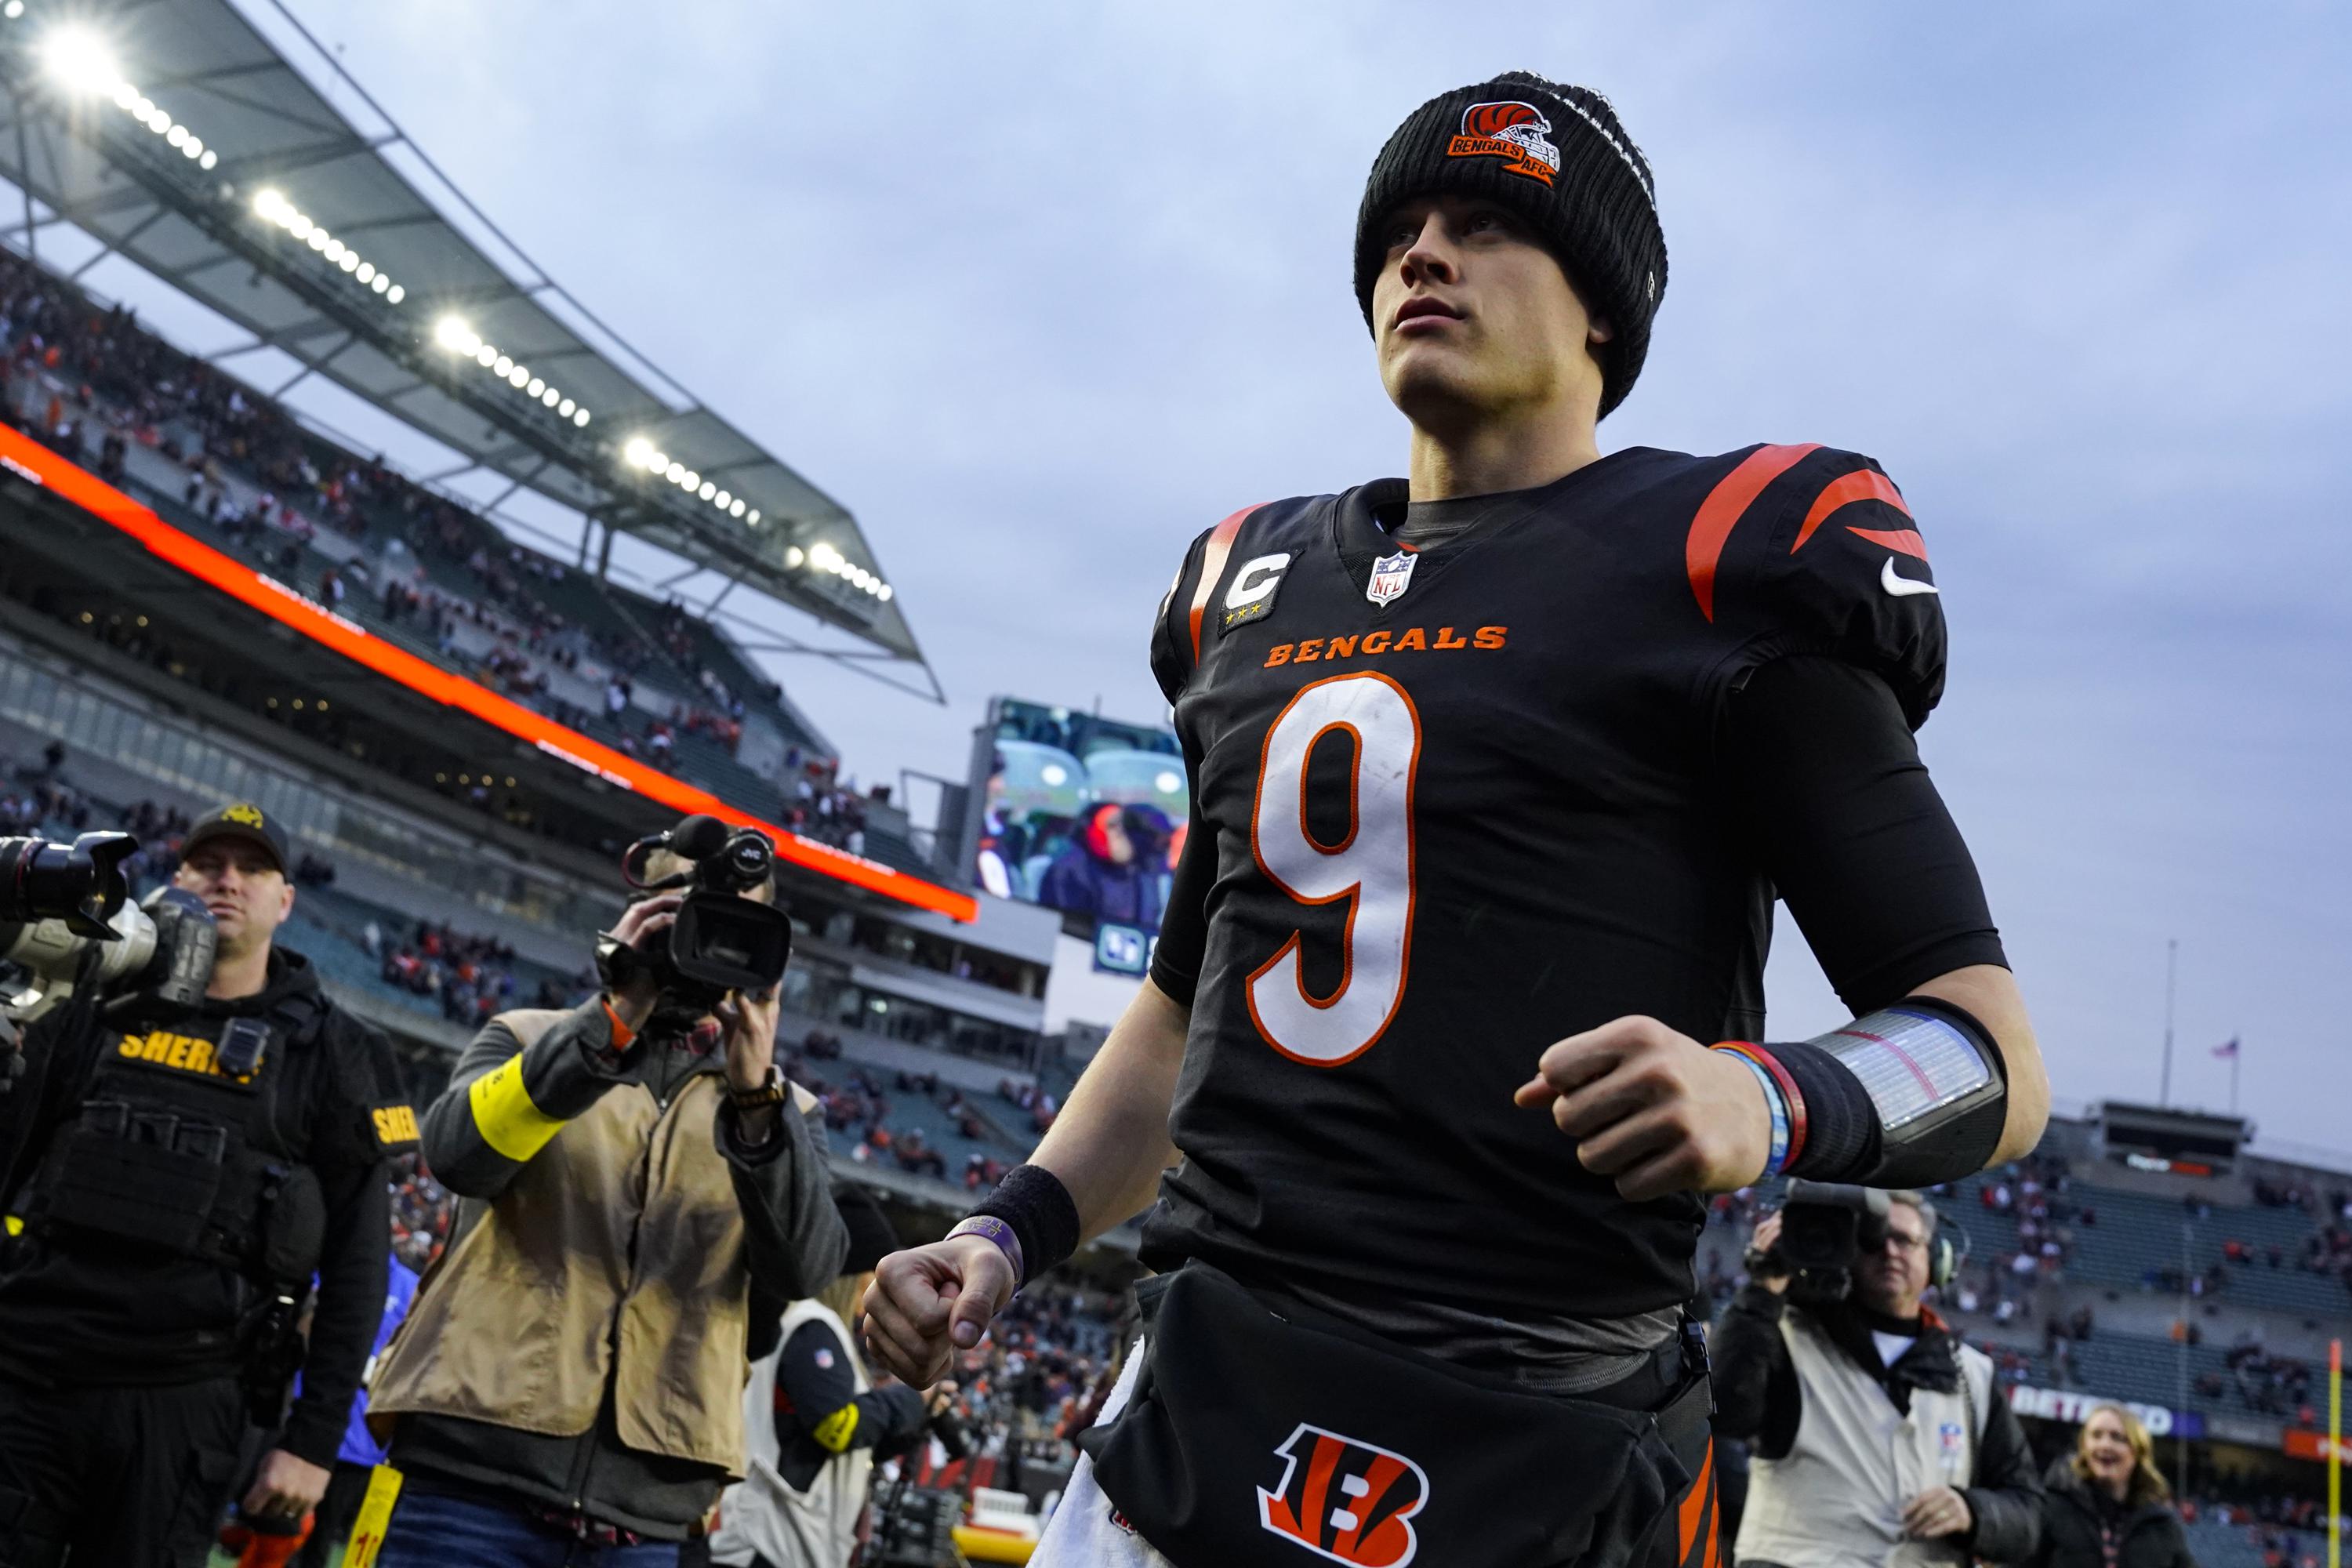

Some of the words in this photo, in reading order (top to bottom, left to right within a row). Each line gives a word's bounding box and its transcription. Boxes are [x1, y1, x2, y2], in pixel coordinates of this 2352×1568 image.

[1452, 138, 1521, 157] BENGALS
[1521, 159, 1548, 176] AFC
[1225, 553, 1291, 610] C
[1373, 573, 1402, 596] NFL
[1263, 626, 1508, 668] BENGALS
[1246, 670, 1421, 1067] 9
